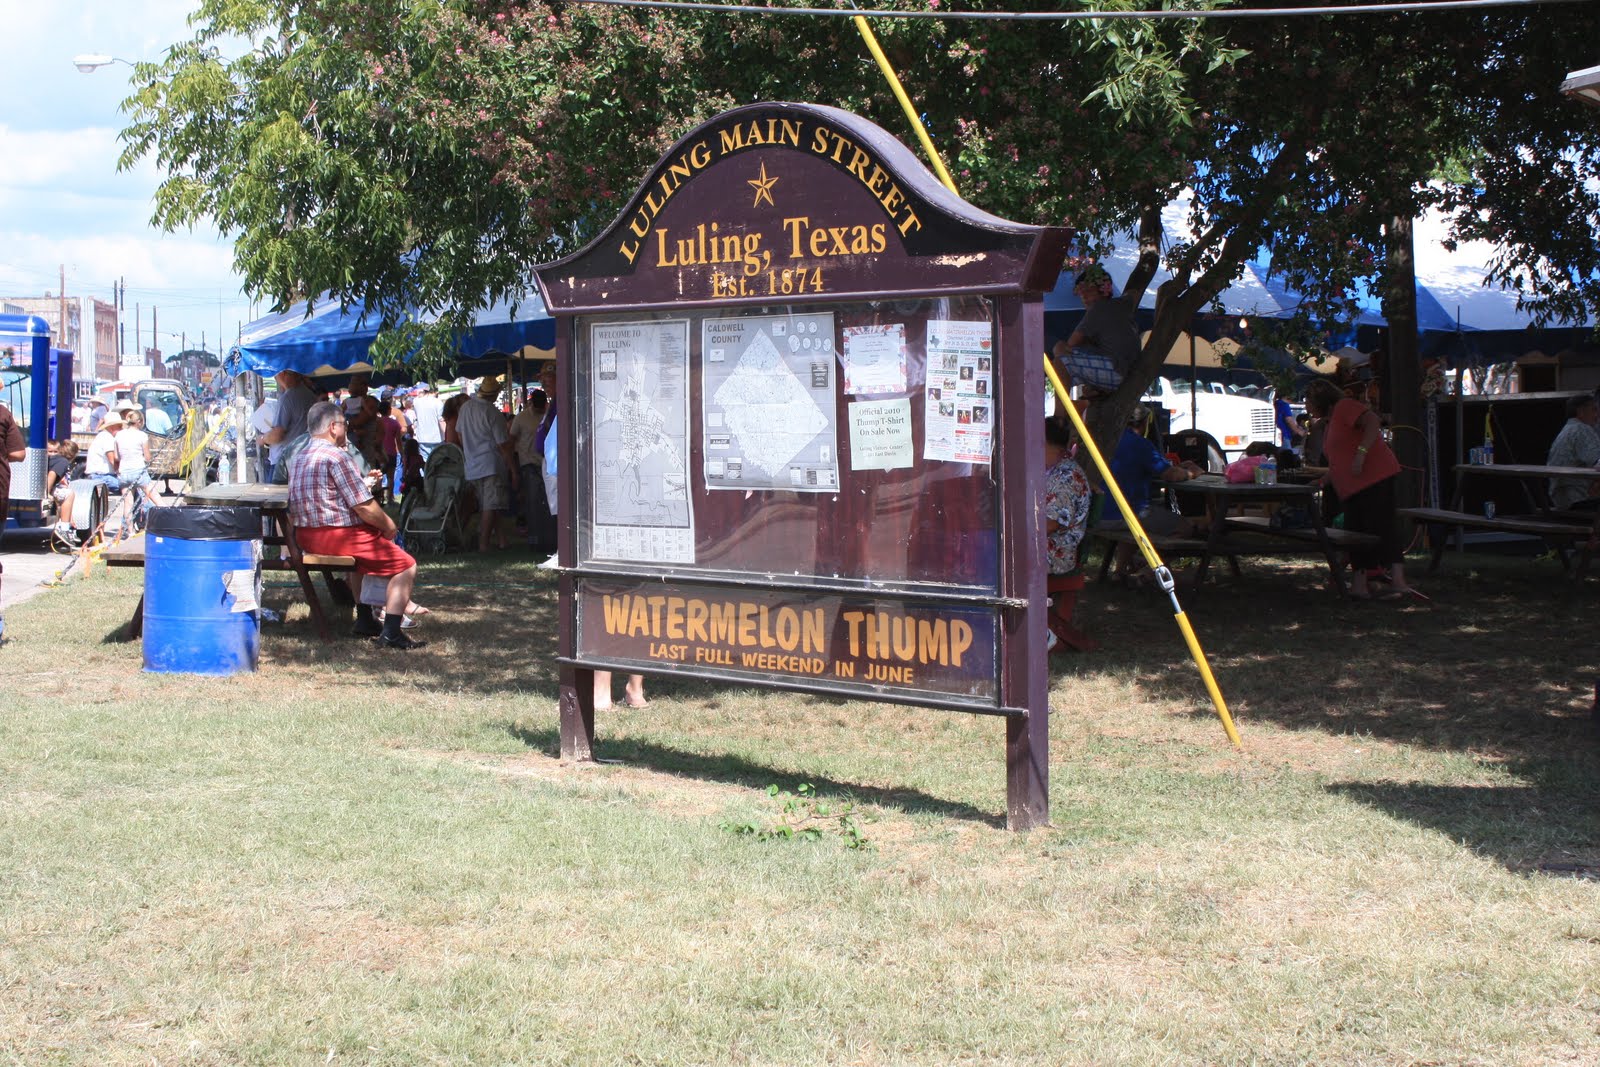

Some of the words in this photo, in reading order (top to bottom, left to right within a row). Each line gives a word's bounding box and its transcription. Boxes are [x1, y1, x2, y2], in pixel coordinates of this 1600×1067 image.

[618, 140, 712, 264] LULING
[719, 118, 803, 155] MAIN
[811, 127, 922, 237] STREET
[655, 224, 772, 276] Luling,
[783, 217, 887, 259] Texas
[712, 271, 754, 298] Est.
[767, 267, 824, 294] 1874
[707, 323, 745, 332] CALDWELL
[598, 330, 631, 339] WELCOME
[632, 329, 641, 338] TO
[607, 340, 631, 349] LULING
[711, 335, 742, 344] COUNTY
[859, 407, 883, 416] Official
[856, 418, 880, 427] Thump
[881, 416, 905, 425] T-Shirt
[871, 428, 885, 436] Sale
[886, 427, 901, 435] Now
[602, 594, 825, 653] WATERMELON
[843, 611, 973, 667] THUMP
[650, 642, 688, 661] LAST
[695, 647, 734, 666] FULL
[742, 651, 825, 674] WEEKEND
[835, 660, 855, 678] IN
[864, 663, 914, 684] JUNE
